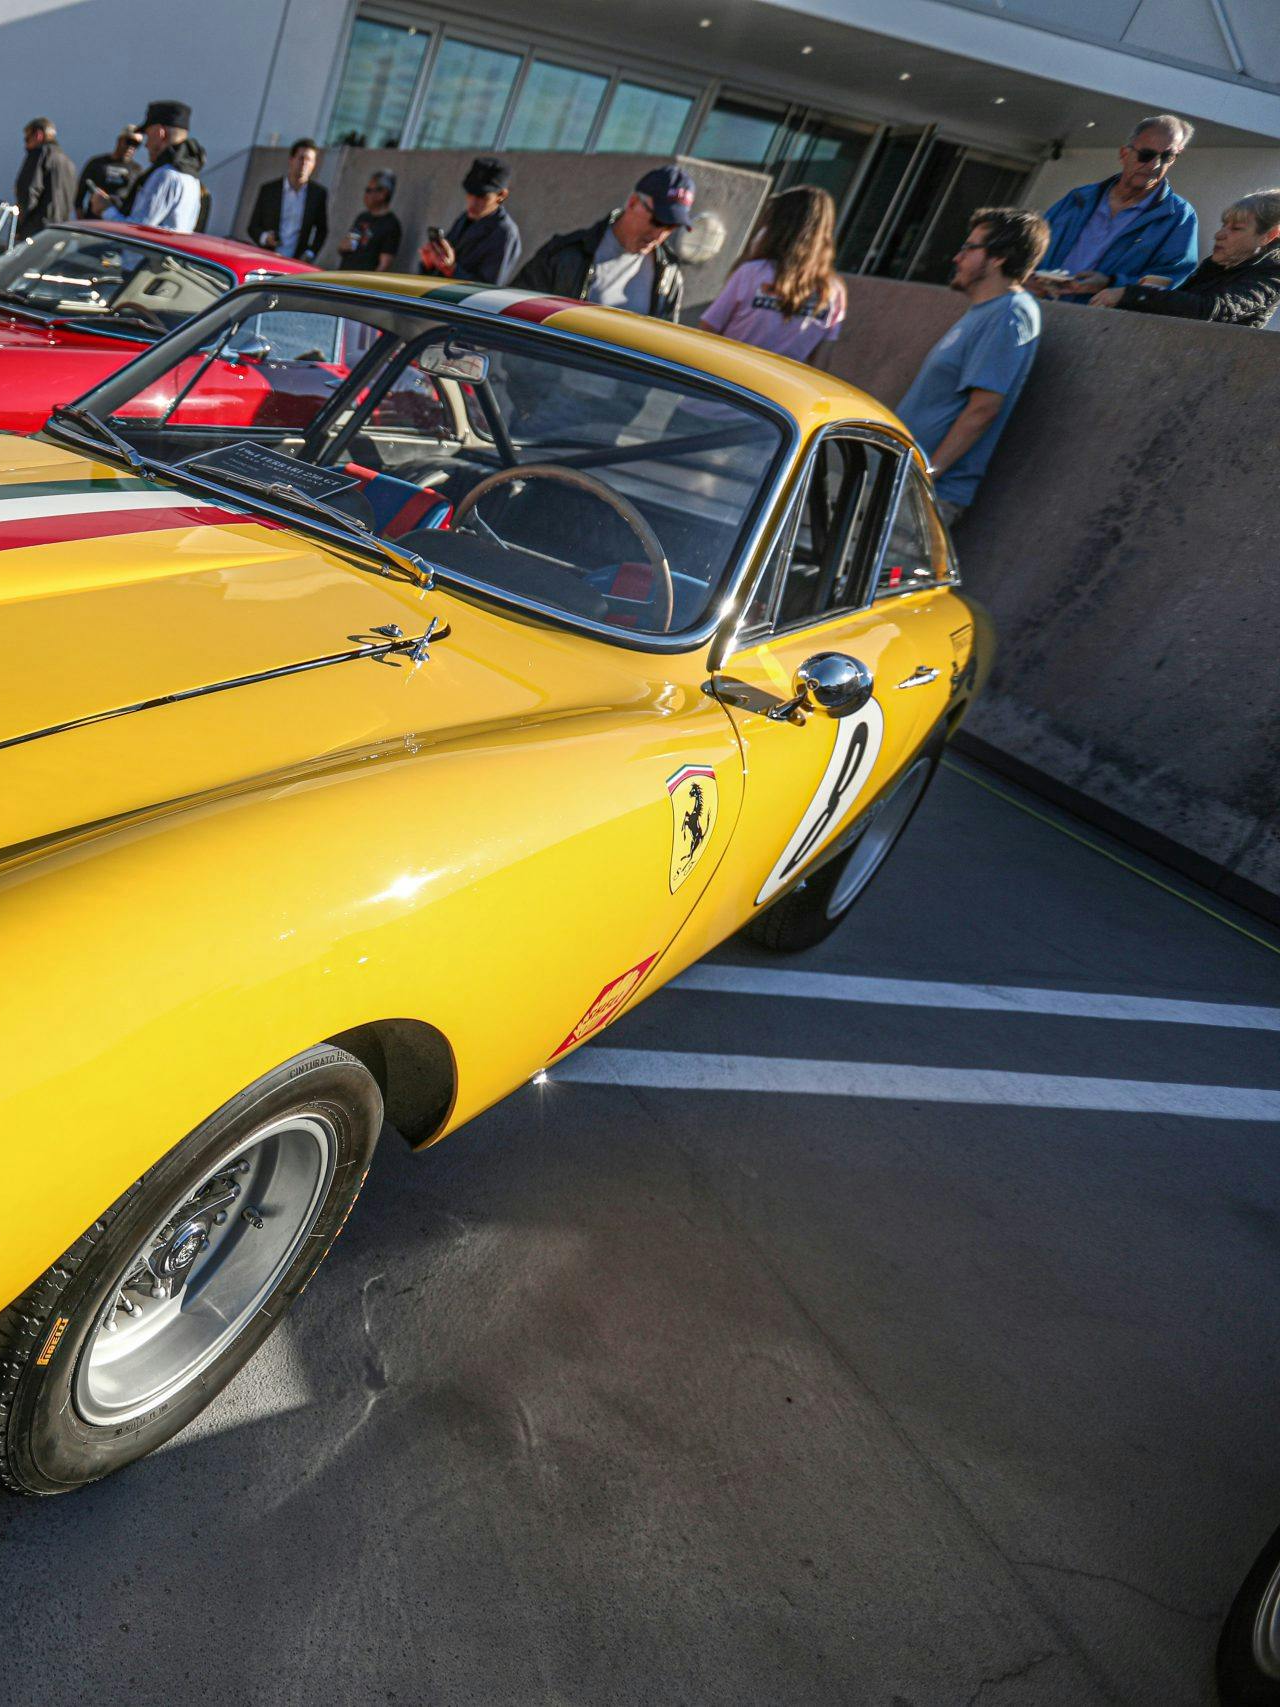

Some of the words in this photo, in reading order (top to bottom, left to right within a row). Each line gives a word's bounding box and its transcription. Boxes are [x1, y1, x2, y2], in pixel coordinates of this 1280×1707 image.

[261, 456, 304, 474] FERRARI
[779, 721, 869, 878] 8
[289, 1055, 335, 1079] CINTURATO
[36, 1316, 69, 1366] PIRELLI
